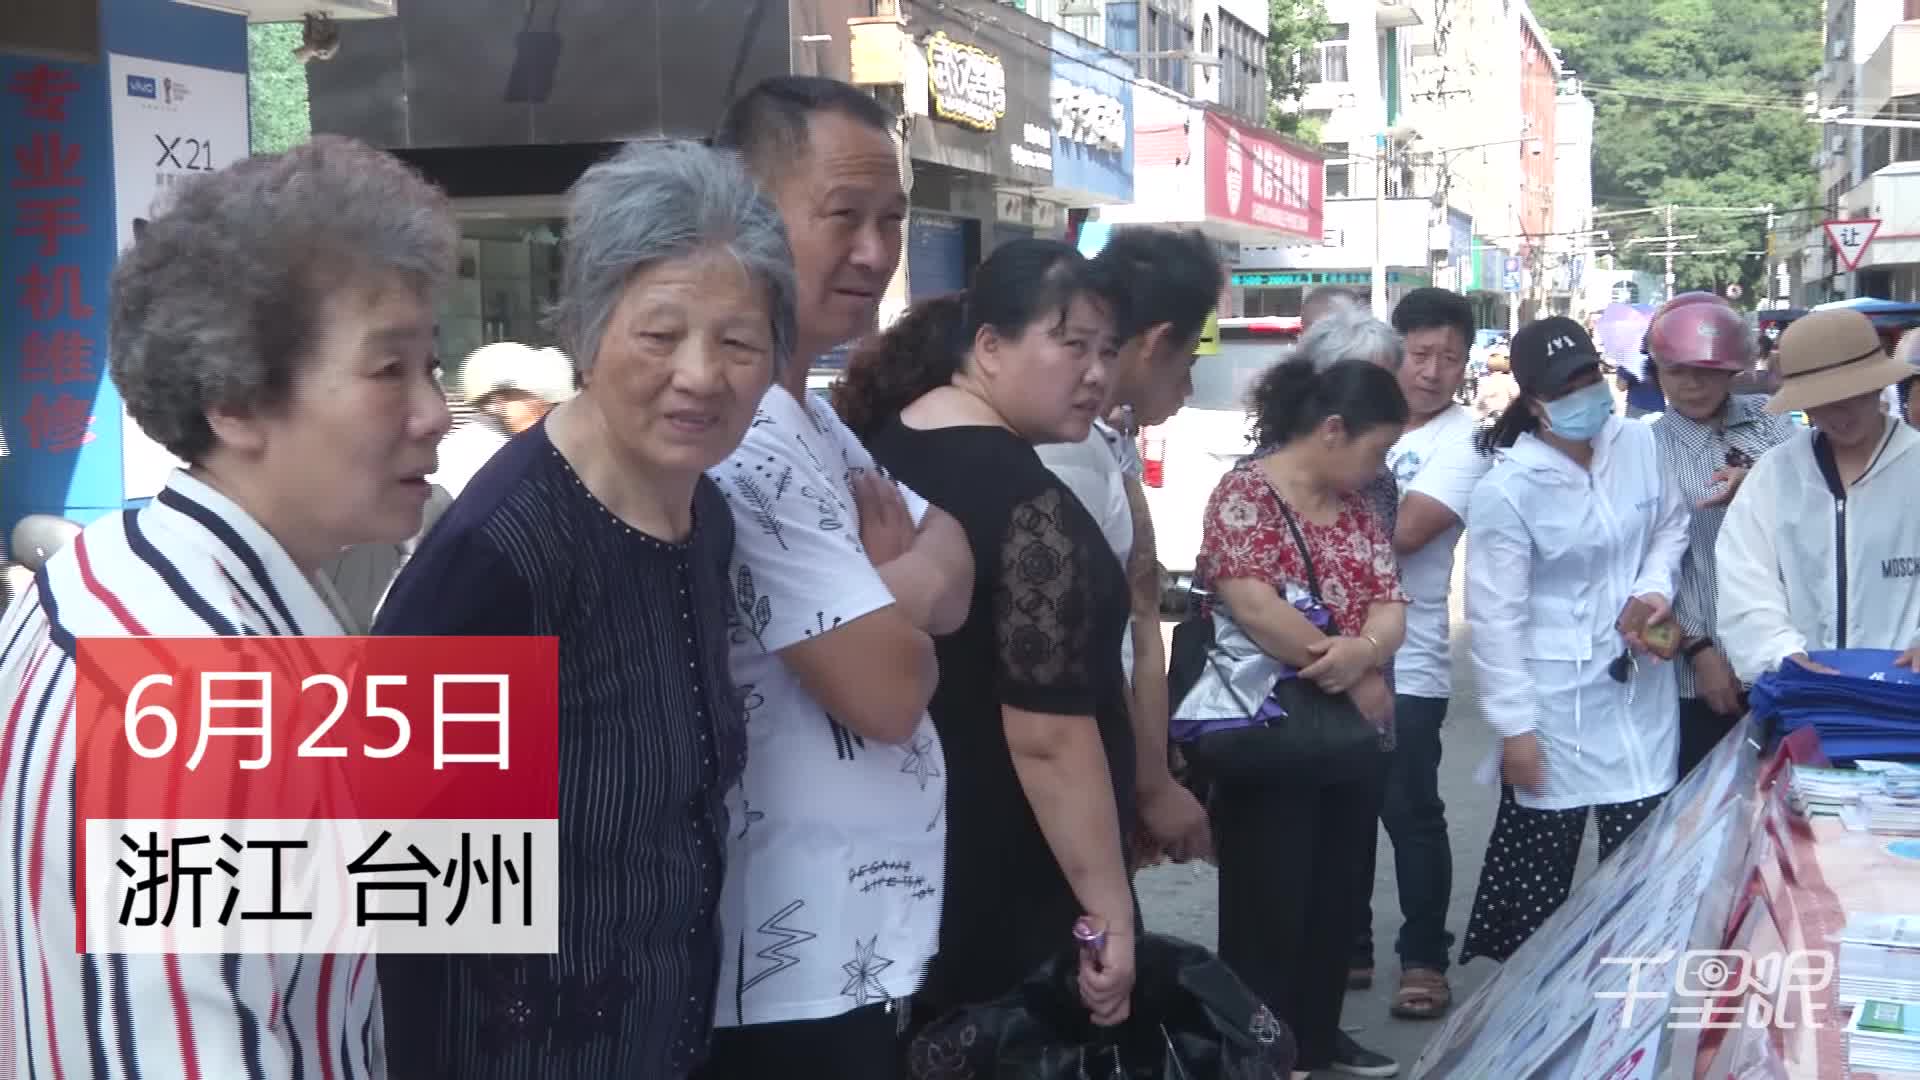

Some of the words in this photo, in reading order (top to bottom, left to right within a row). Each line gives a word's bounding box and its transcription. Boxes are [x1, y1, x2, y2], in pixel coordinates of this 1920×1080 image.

[155, 134, 214, 171] X21
[1840, 227, 1860, 247] 让
[8, 64, 96, 453] 专业手机维修
